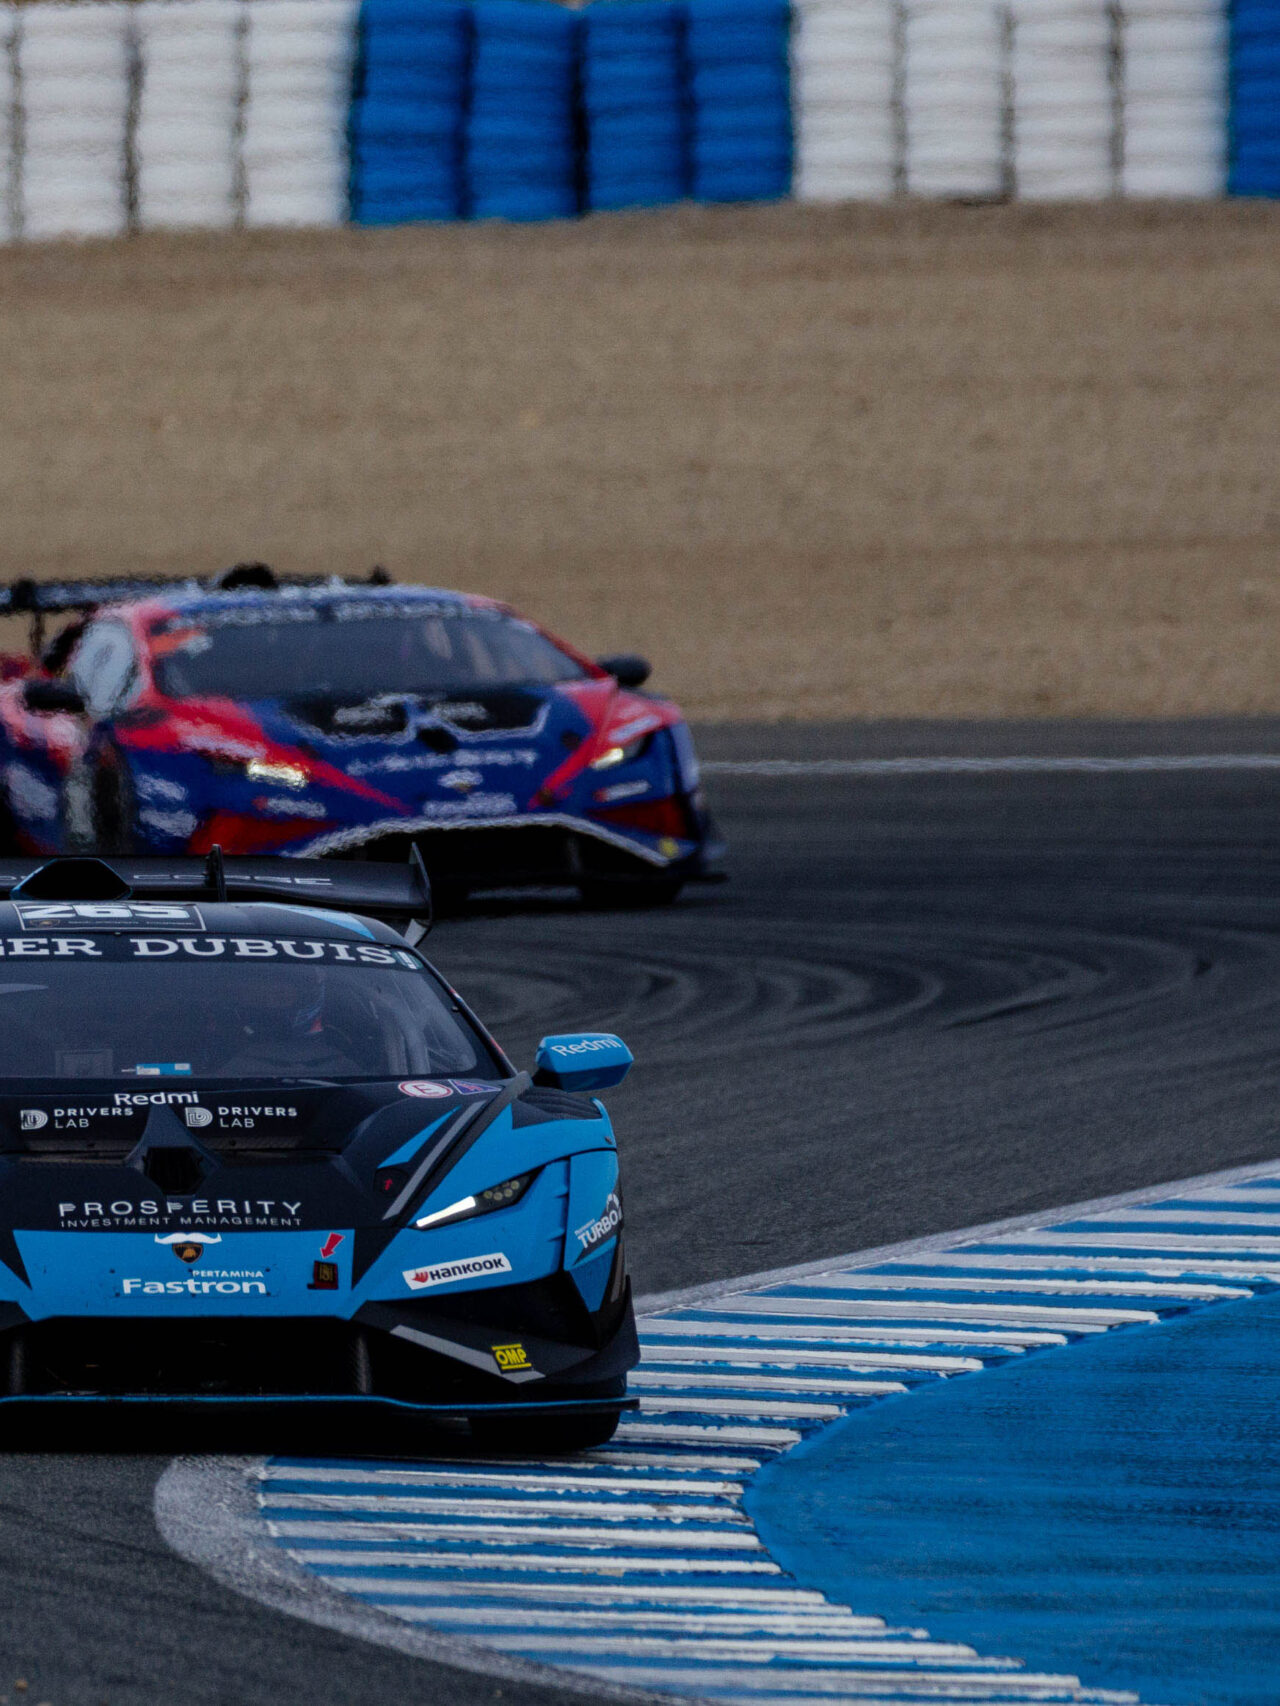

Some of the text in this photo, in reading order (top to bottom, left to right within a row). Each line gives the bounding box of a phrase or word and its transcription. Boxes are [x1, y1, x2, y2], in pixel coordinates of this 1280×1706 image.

[19, 904, 191, 920] 265
[129, 937, 398, 965] DUBUIS
[550, 1038, 623, 1057] Redmi
[113, 1090, 200, 1106] Redmi
[53, 1107, 134, 1118] DRIVERS
[218, 1106, 299, 1117] DRIVERS
[54, 1118, 90, 1129] LAB
[219, 1117, 256, 1129] LAB
[58, 1200, 303, 1217] PROSPERITY
[60, 1216, 303, 1228] INVESTMENT MANAGEMENT
[192, 1269, 265, 1278] PERTAMINA
[122, 1278, 267, 1295] Fastron
[495, 1348, 527, 1366] OMP
